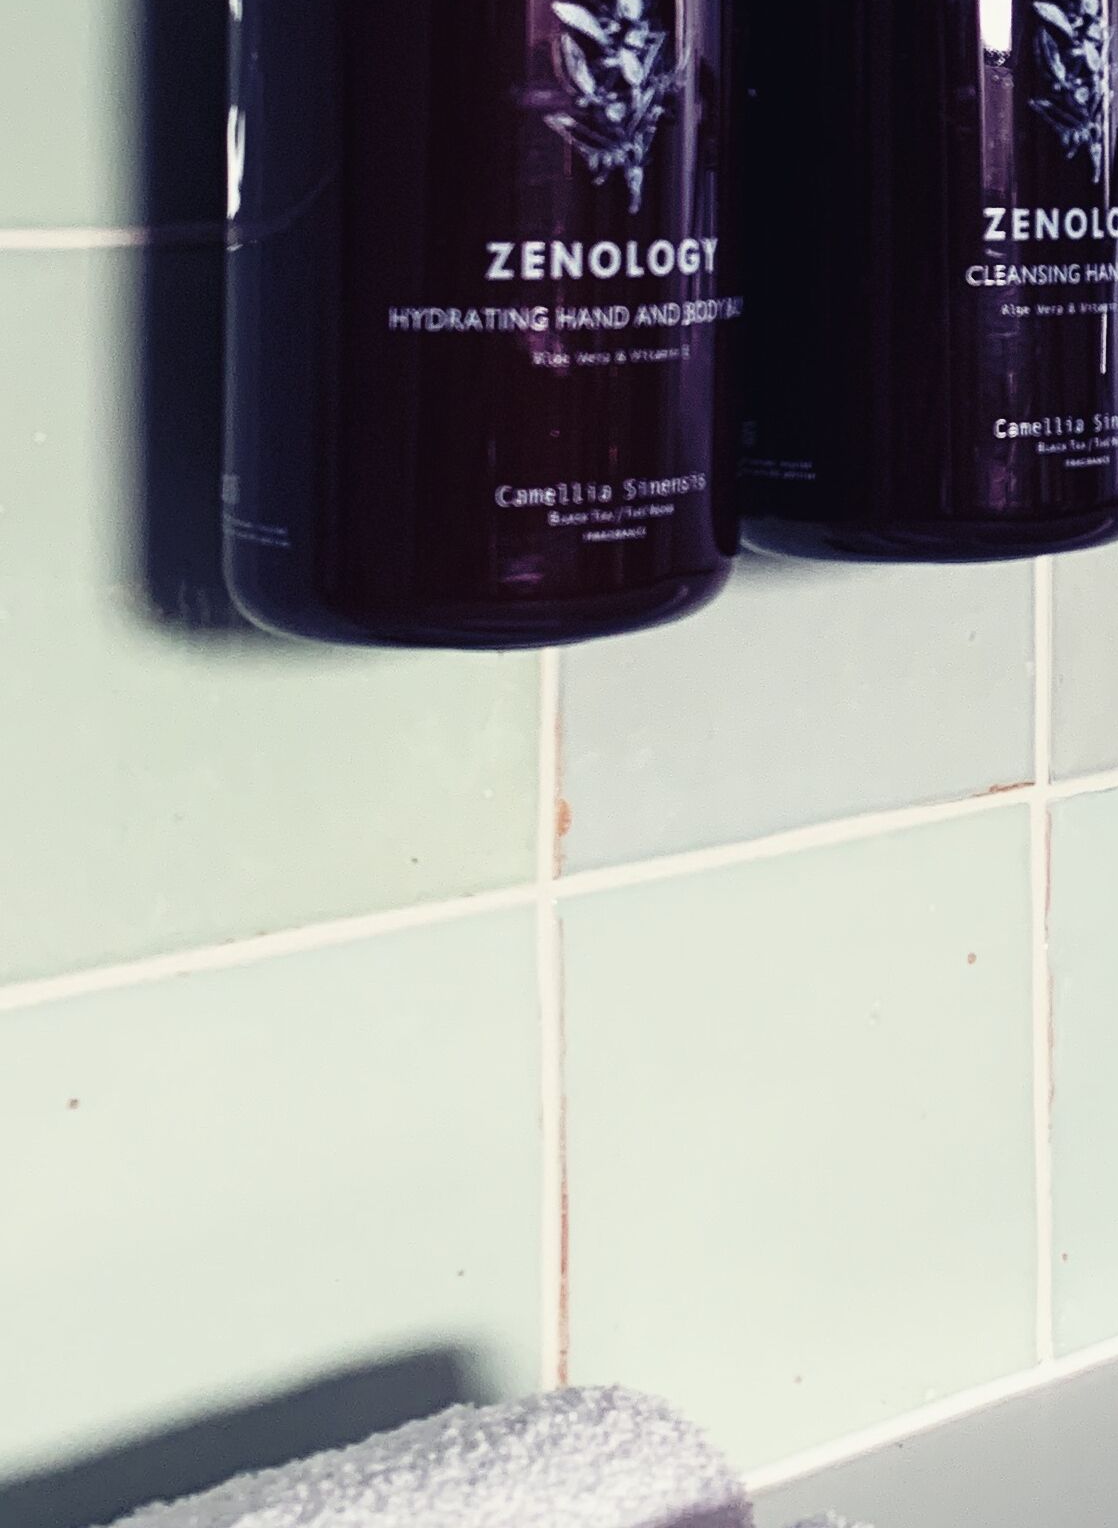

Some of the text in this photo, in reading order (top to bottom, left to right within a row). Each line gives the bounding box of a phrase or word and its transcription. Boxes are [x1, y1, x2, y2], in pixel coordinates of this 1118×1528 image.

[485, 238, 718, 280] ZENOLOGY
[965, 264, 1081, 287] CLEANSING
[388, 306, 549, 333] HYDRATING
[553, 304, 630, 331] HAND
[634, 301, 681, 327] AND
[681, 297, 725, 326] BODY
[993, 416, 1086, 440] Camellia
[494, 471, 708, 509] Camellia Sinensis
